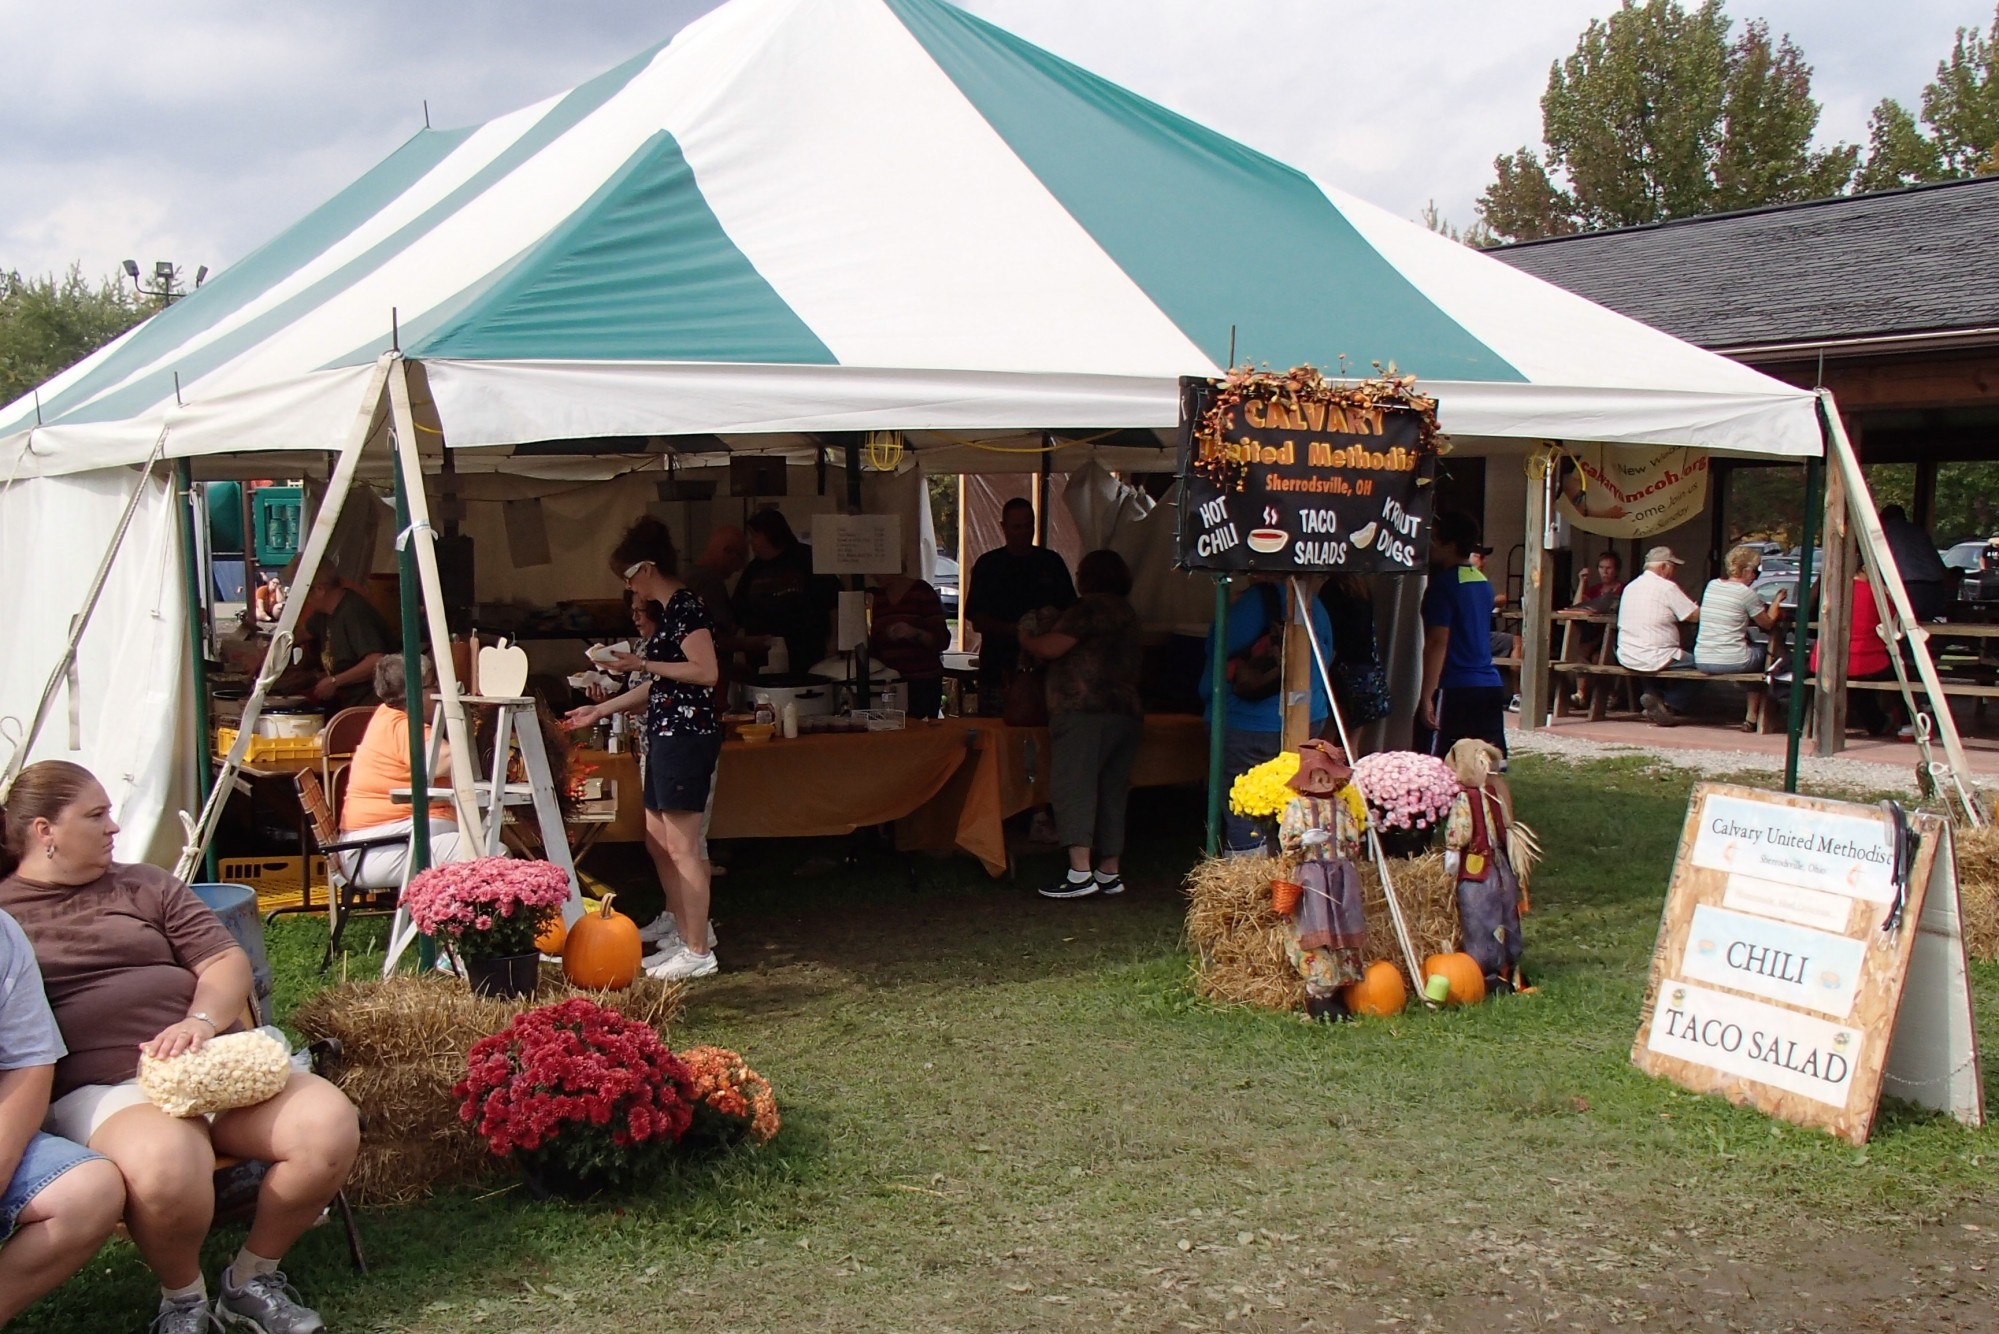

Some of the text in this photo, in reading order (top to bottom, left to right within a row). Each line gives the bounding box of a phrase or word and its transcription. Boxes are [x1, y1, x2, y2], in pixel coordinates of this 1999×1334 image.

[1244, 399, 1384, 436] CALVARY
[1265, 473, 1373, 496] Sherrodsville, OH
[1617, 463, 1647, 476] New
[1198, 495, 1230, 530] HOT
[1299, 509, 1337, 534] TACO
[1197, 522, 1240, 558] CHILI
[1294, 541, 1347, 565] SALADS
[1376, 528, 1415, 567] DOGS
[1711, 818, 1893, 866] Calvary United Methodist
[1726, 940, 1810, 985] CHILI
[1665, 1008, 1848, 1085] TACO SALAD
